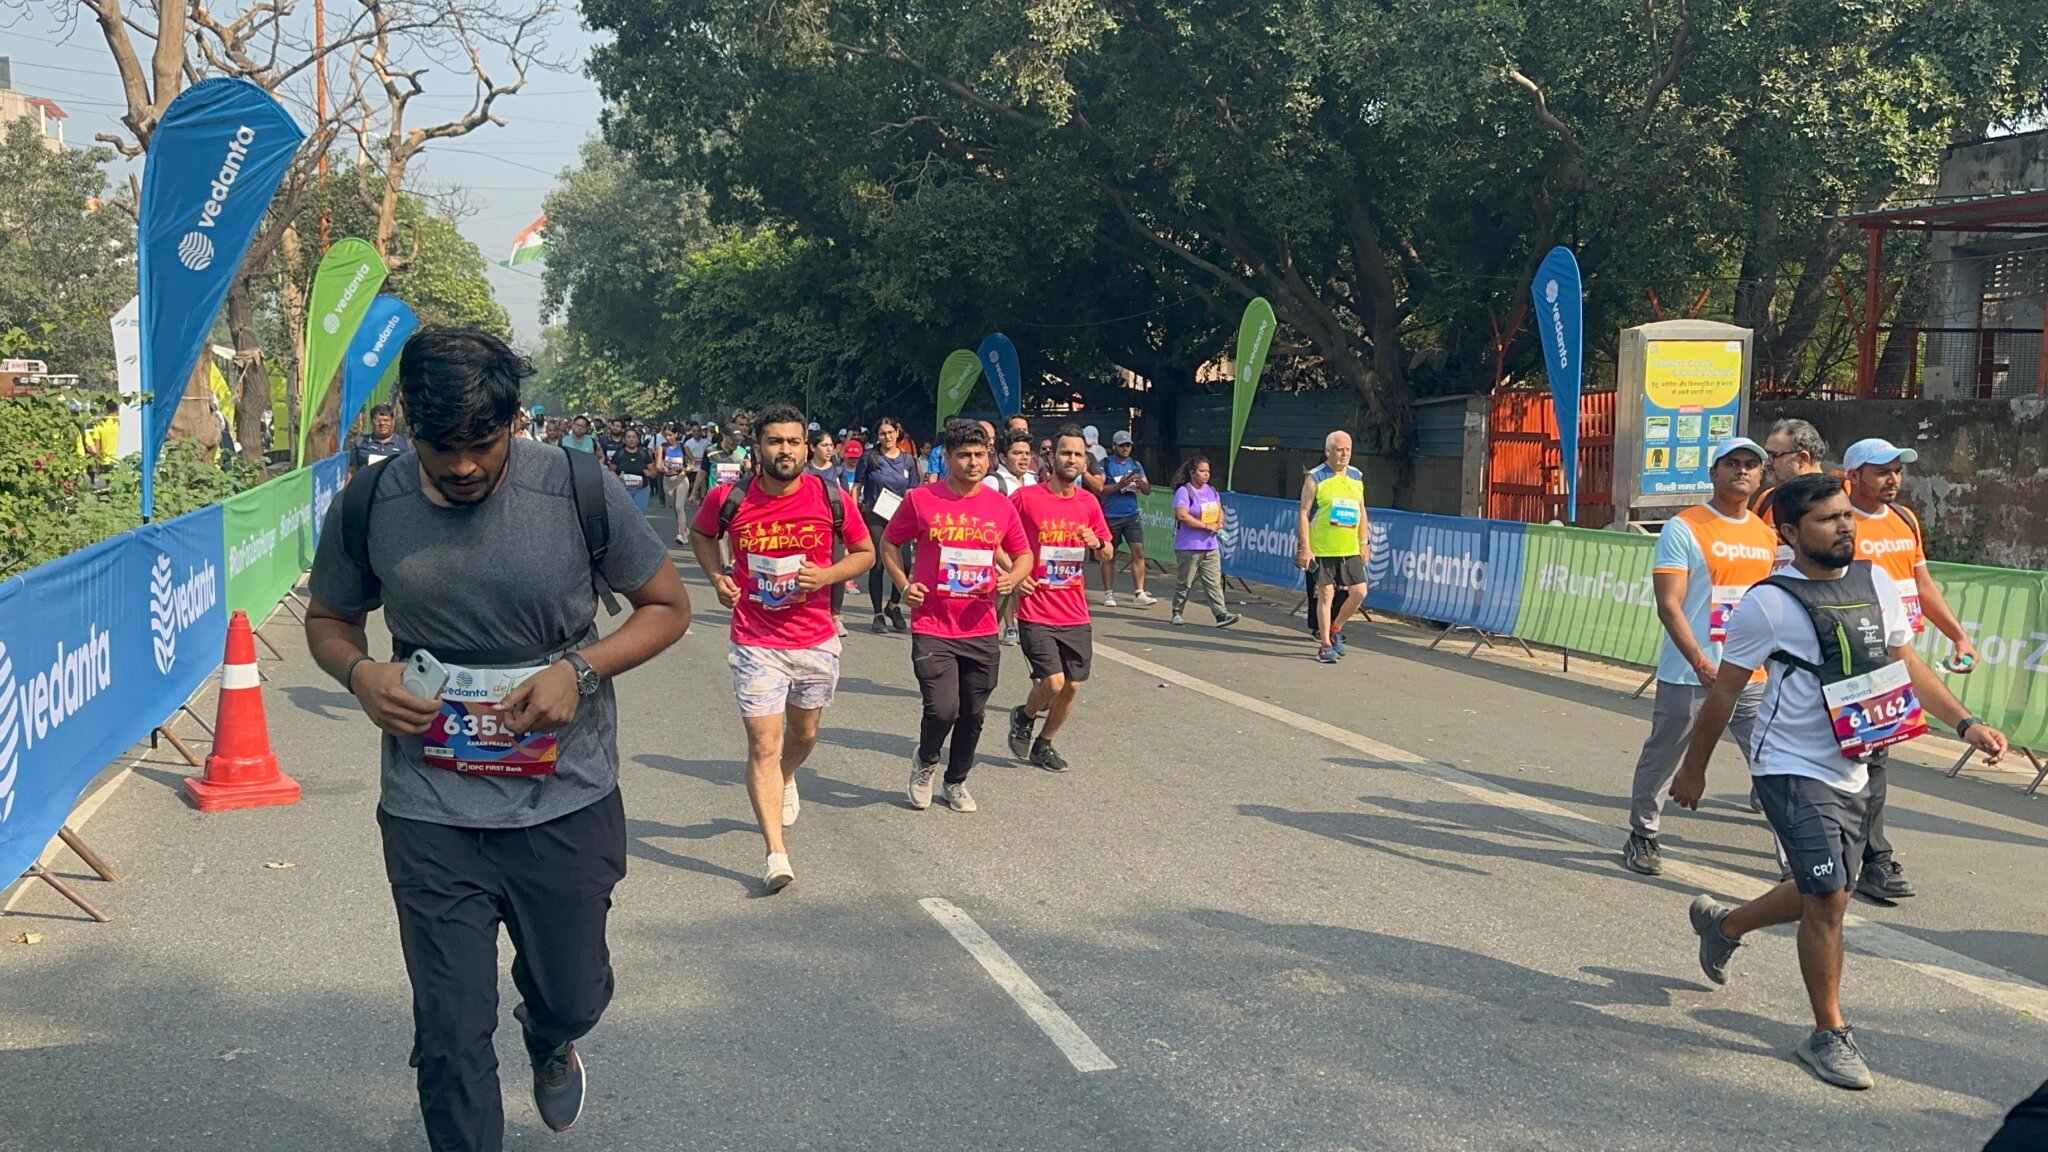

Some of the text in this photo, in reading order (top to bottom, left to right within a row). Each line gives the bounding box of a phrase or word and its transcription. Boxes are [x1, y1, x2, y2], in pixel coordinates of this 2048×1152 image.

[198, 125, 255, 227] vedanta
[335, 264, 370, 313] vedanta
[372, 315, 400, 352] vedanta
[1552, 303, 1568, 369] vedanta
[1240, 524, 1298, 557] vedant
[1711, 541, 1771, 562] Optum
[1860, 538, 1914, 559] Optum
[947, 568, 983, 582] 81836
[1046, 565, 1076, 575] 81943
[1392, 546, 1488, 591] vedanta
[173, 558, 216, 633] vedanta
[757, 578, 796, 593] 80418
[19, 622, 111, 749] vedanta
[1840, 688, 1872, 702] vedanta
[1849, 696, 1908, 728] 61162
